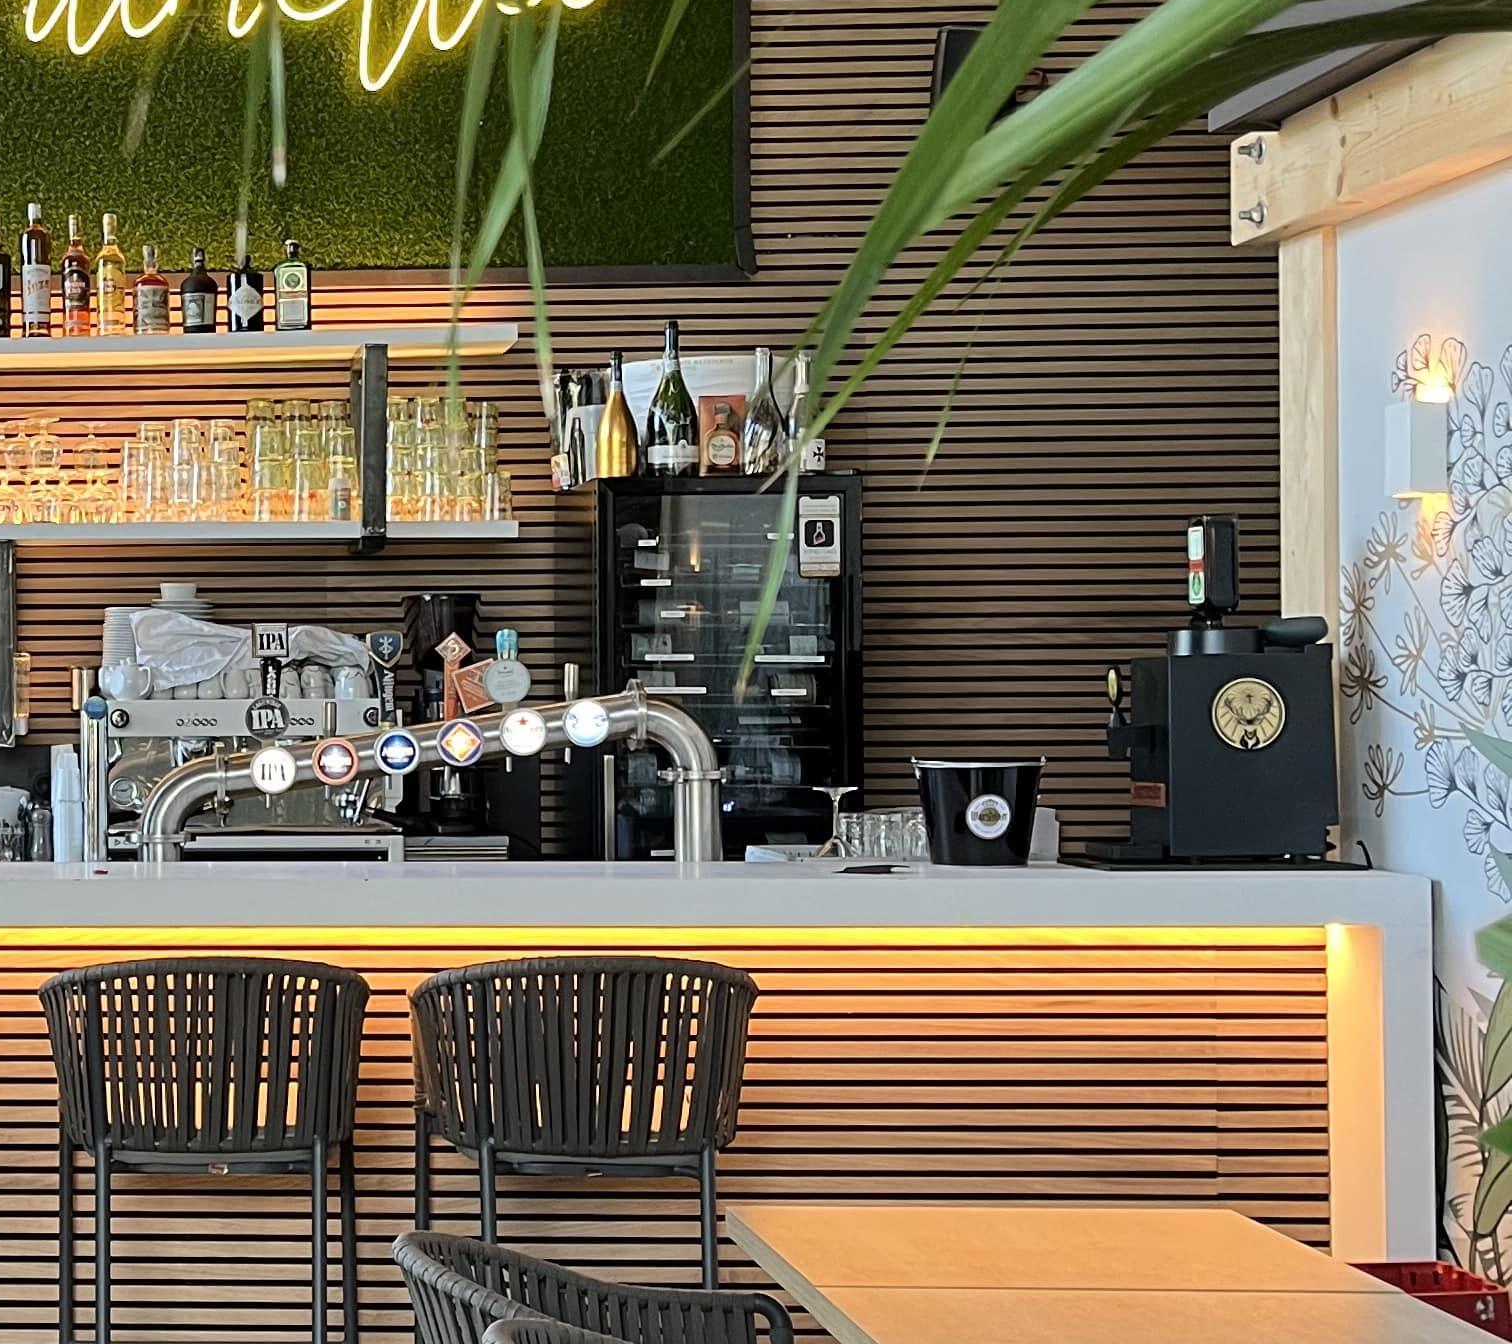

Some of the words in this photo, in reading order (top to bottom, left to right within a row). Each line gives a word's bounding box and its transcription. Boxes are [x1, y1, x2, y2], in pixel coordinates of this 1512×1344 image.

[257, 632, 286, 651] IPA
[251, 708, 286, 731] IPA
[260, 763, 287, 782] IPA
